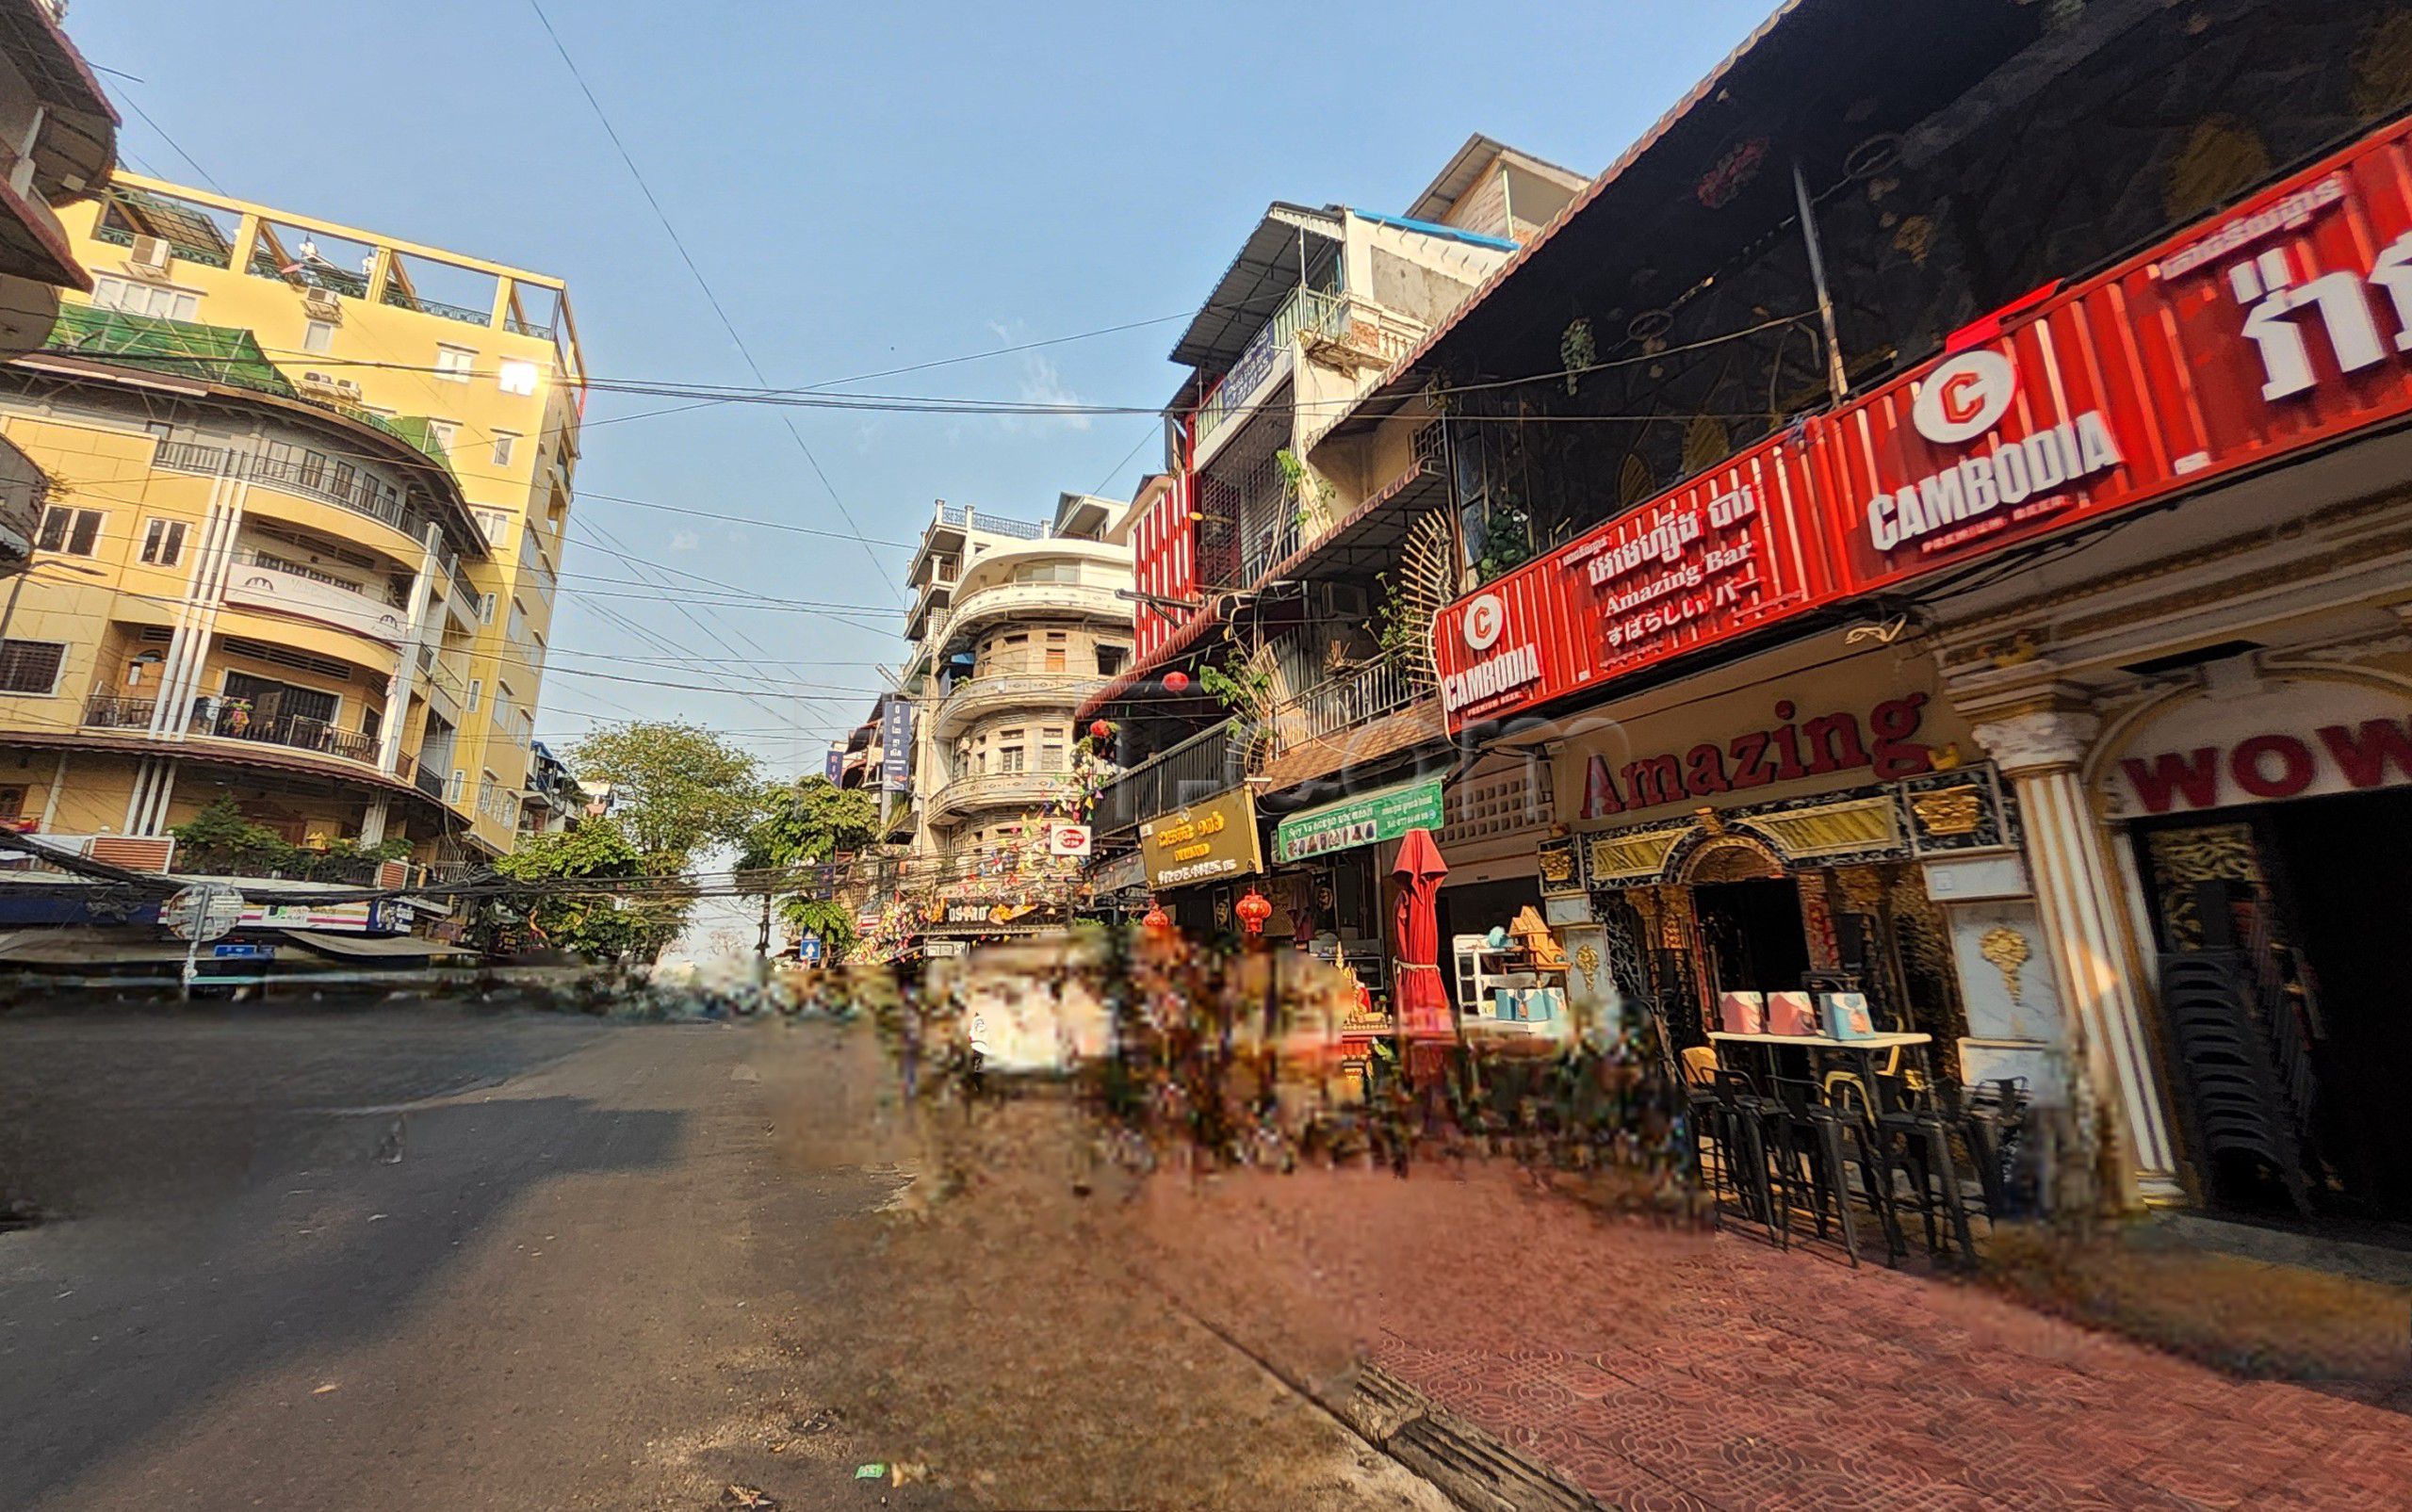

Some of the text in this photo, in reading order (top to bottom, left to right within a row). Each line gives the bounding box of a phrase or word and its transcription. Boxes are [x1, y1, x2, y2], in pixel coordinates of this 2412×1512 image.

[1866, 410, 2124, 551] CAMBODIA
[1921, 495, 2071, 554] PREMIUM BEER
[1605, 542, 1753, 618] Amazing Bar
[1605, 576, 1761, 647] すばらしい バー
[1443, 642, 1540, 712] CAMBODIA
[1579, 691, 1933, 820] Amazing
[2120, 717, 2412, 814] WOW
